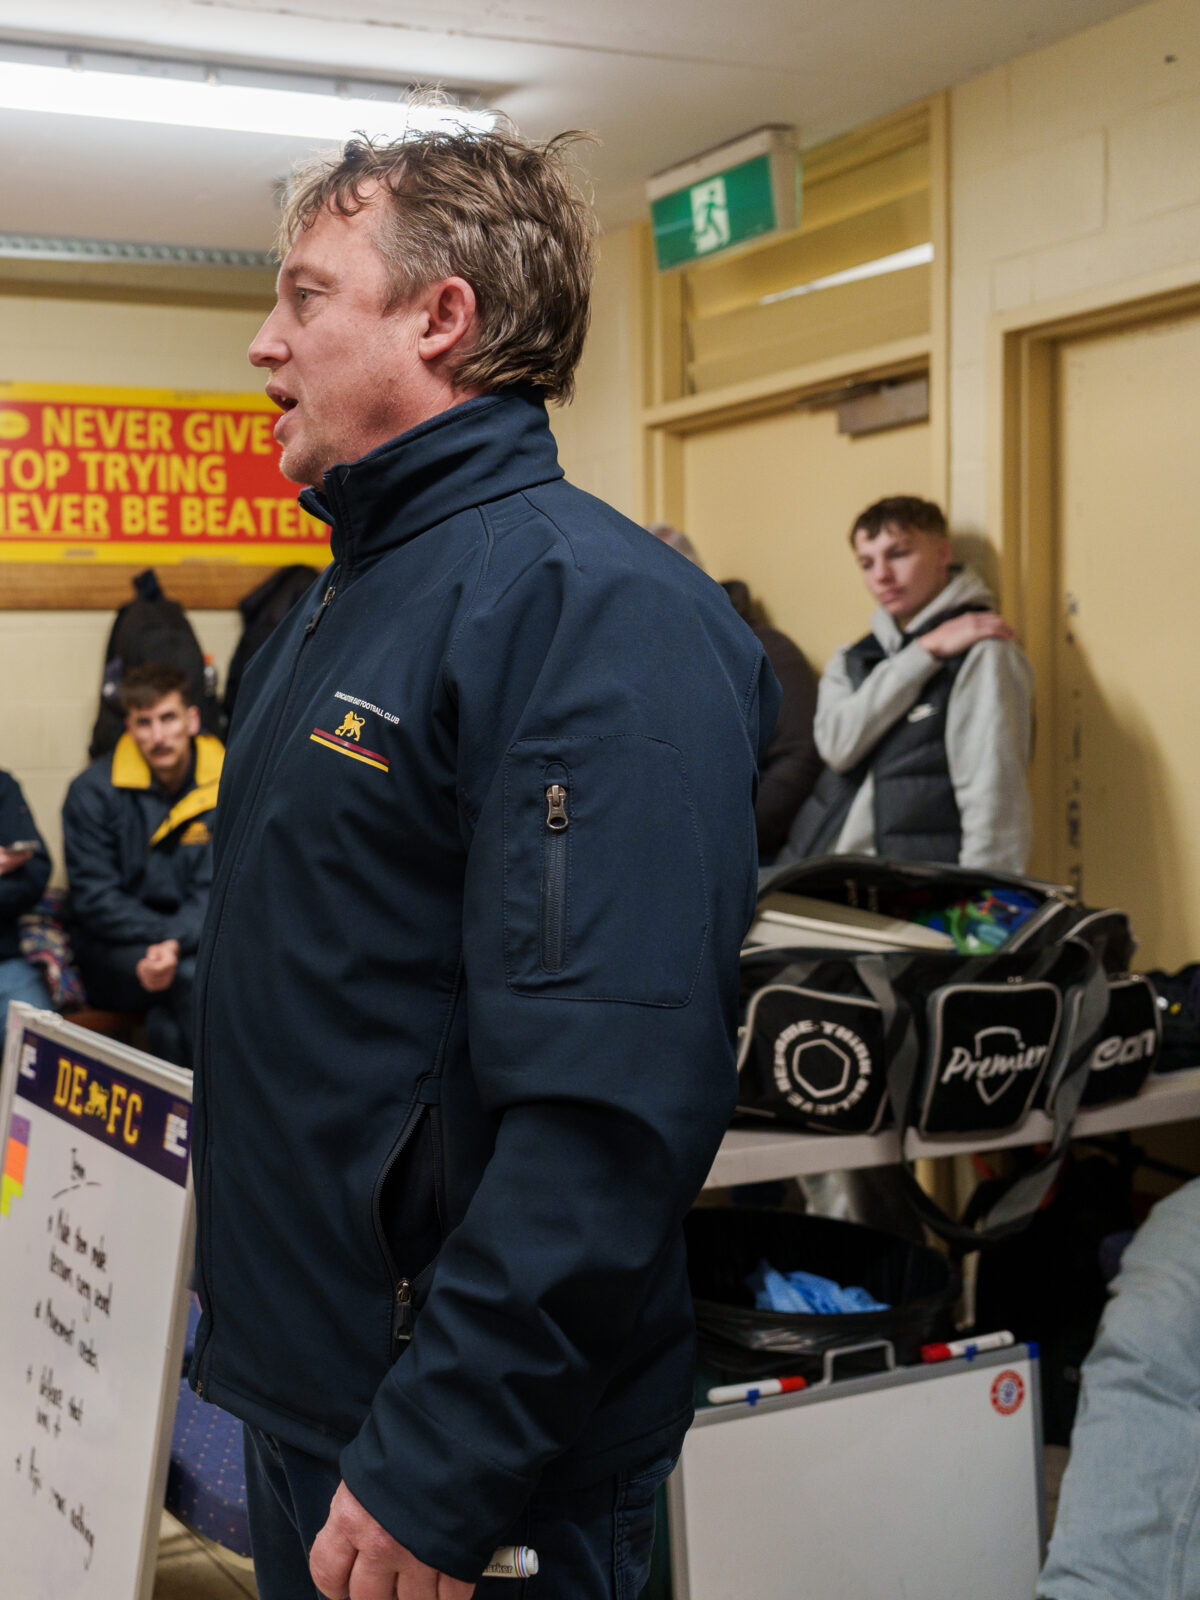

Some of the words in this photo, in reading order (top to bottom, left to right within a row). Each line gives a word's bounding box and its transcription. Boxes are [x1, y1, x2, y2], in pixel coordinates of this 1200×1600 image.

[41, 406, 174, 450] NEVER
[183, 411, 274, 455] GIVE
[78, 452, 228, 495] TRYING
[121, 495, 170, 536] BE
[180, 496, 325, 538] BEATEN
[360, 700, 384, 717] FOOTBALL
[384, 712, 400, 725] CLUB
[941, 1045, 1048, 1084] Premier
[53, 1057, 88, 1117] DE
[106, 1083, 143, 1145] FC
[484, 1562, 513, 1573] arker
